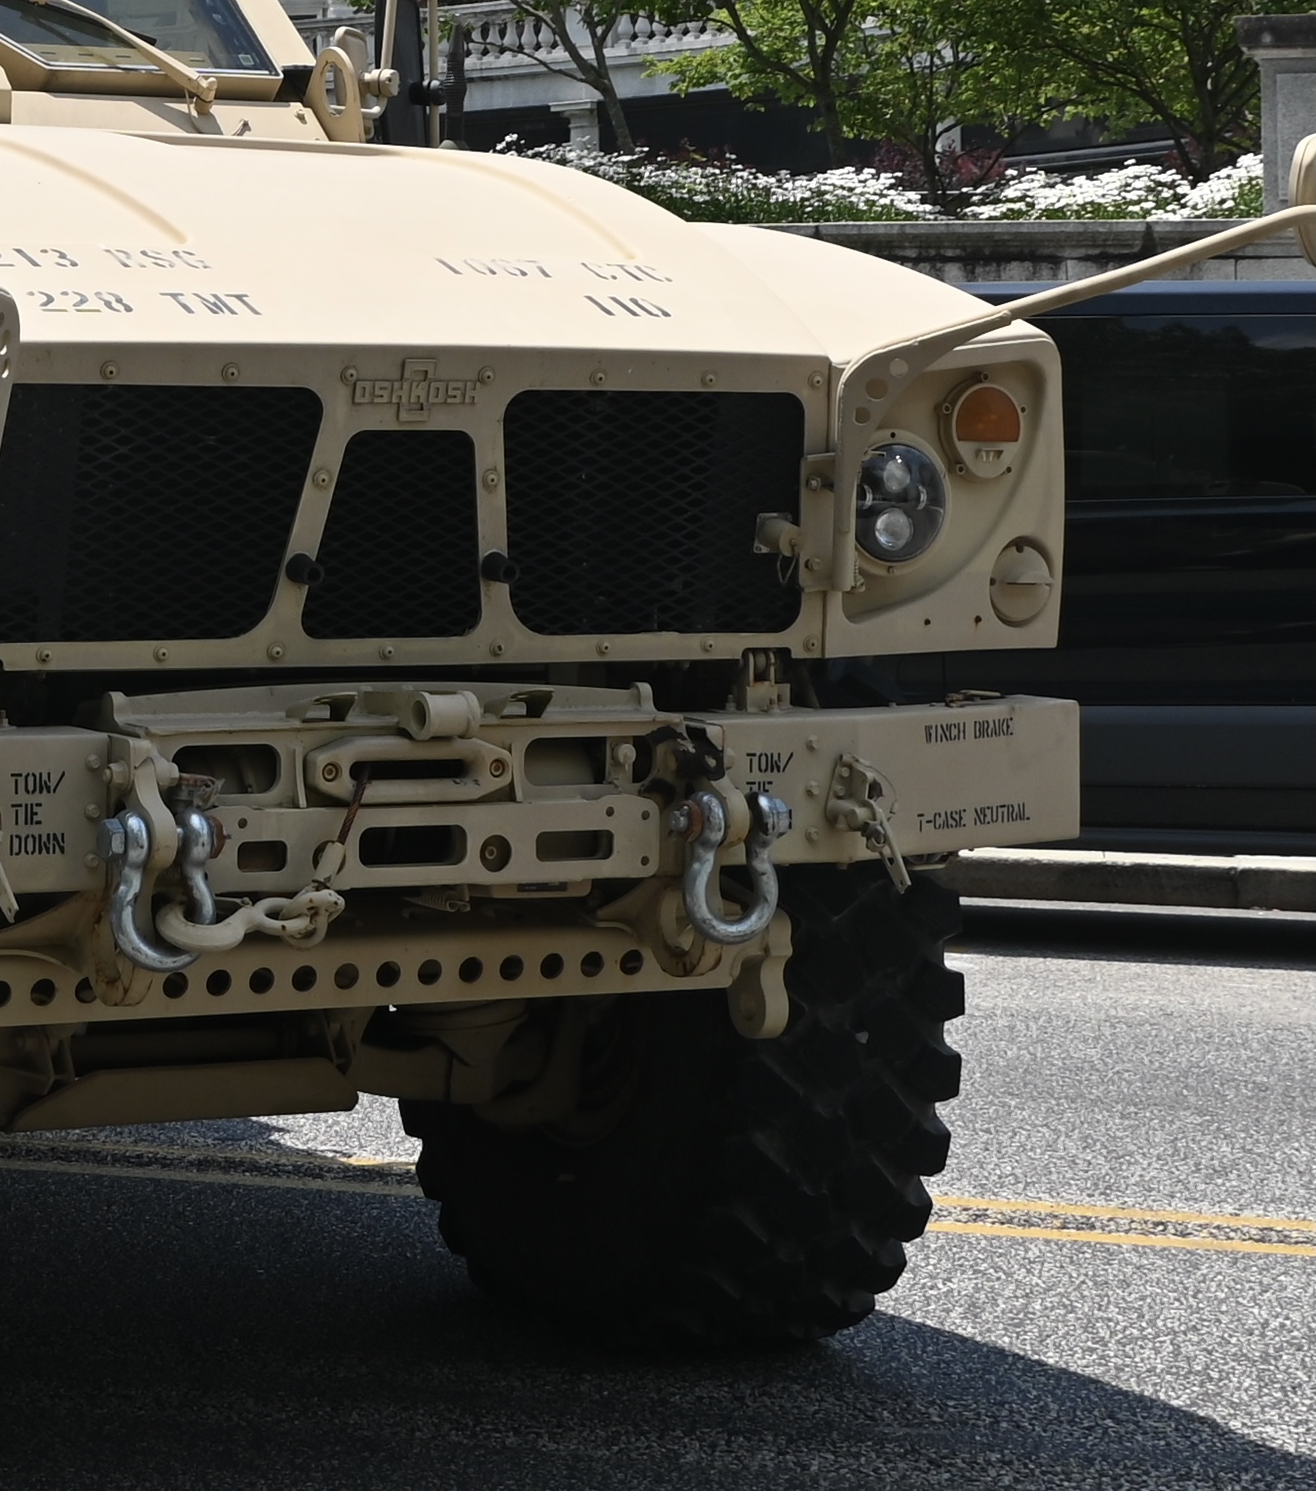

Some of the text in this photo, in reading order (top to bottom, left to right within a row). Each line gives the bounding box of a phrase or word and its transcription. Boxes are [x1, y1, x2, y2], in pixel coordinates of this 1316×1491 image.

[26, 291, 263, 315] 228 TMT
[353, 380, 481, 405] OSHKOSH
[924, 717, 1014, 744] WINCH BRAKE
[746, 751, 794, 774] TOW/
[10, 770, 66, 795] TOW/
[10, 802, 43, 826] TIE
[916, 802, 1031, 833] T-CASE NEUTRAL
[9, 832, 66, 857] DOWN
